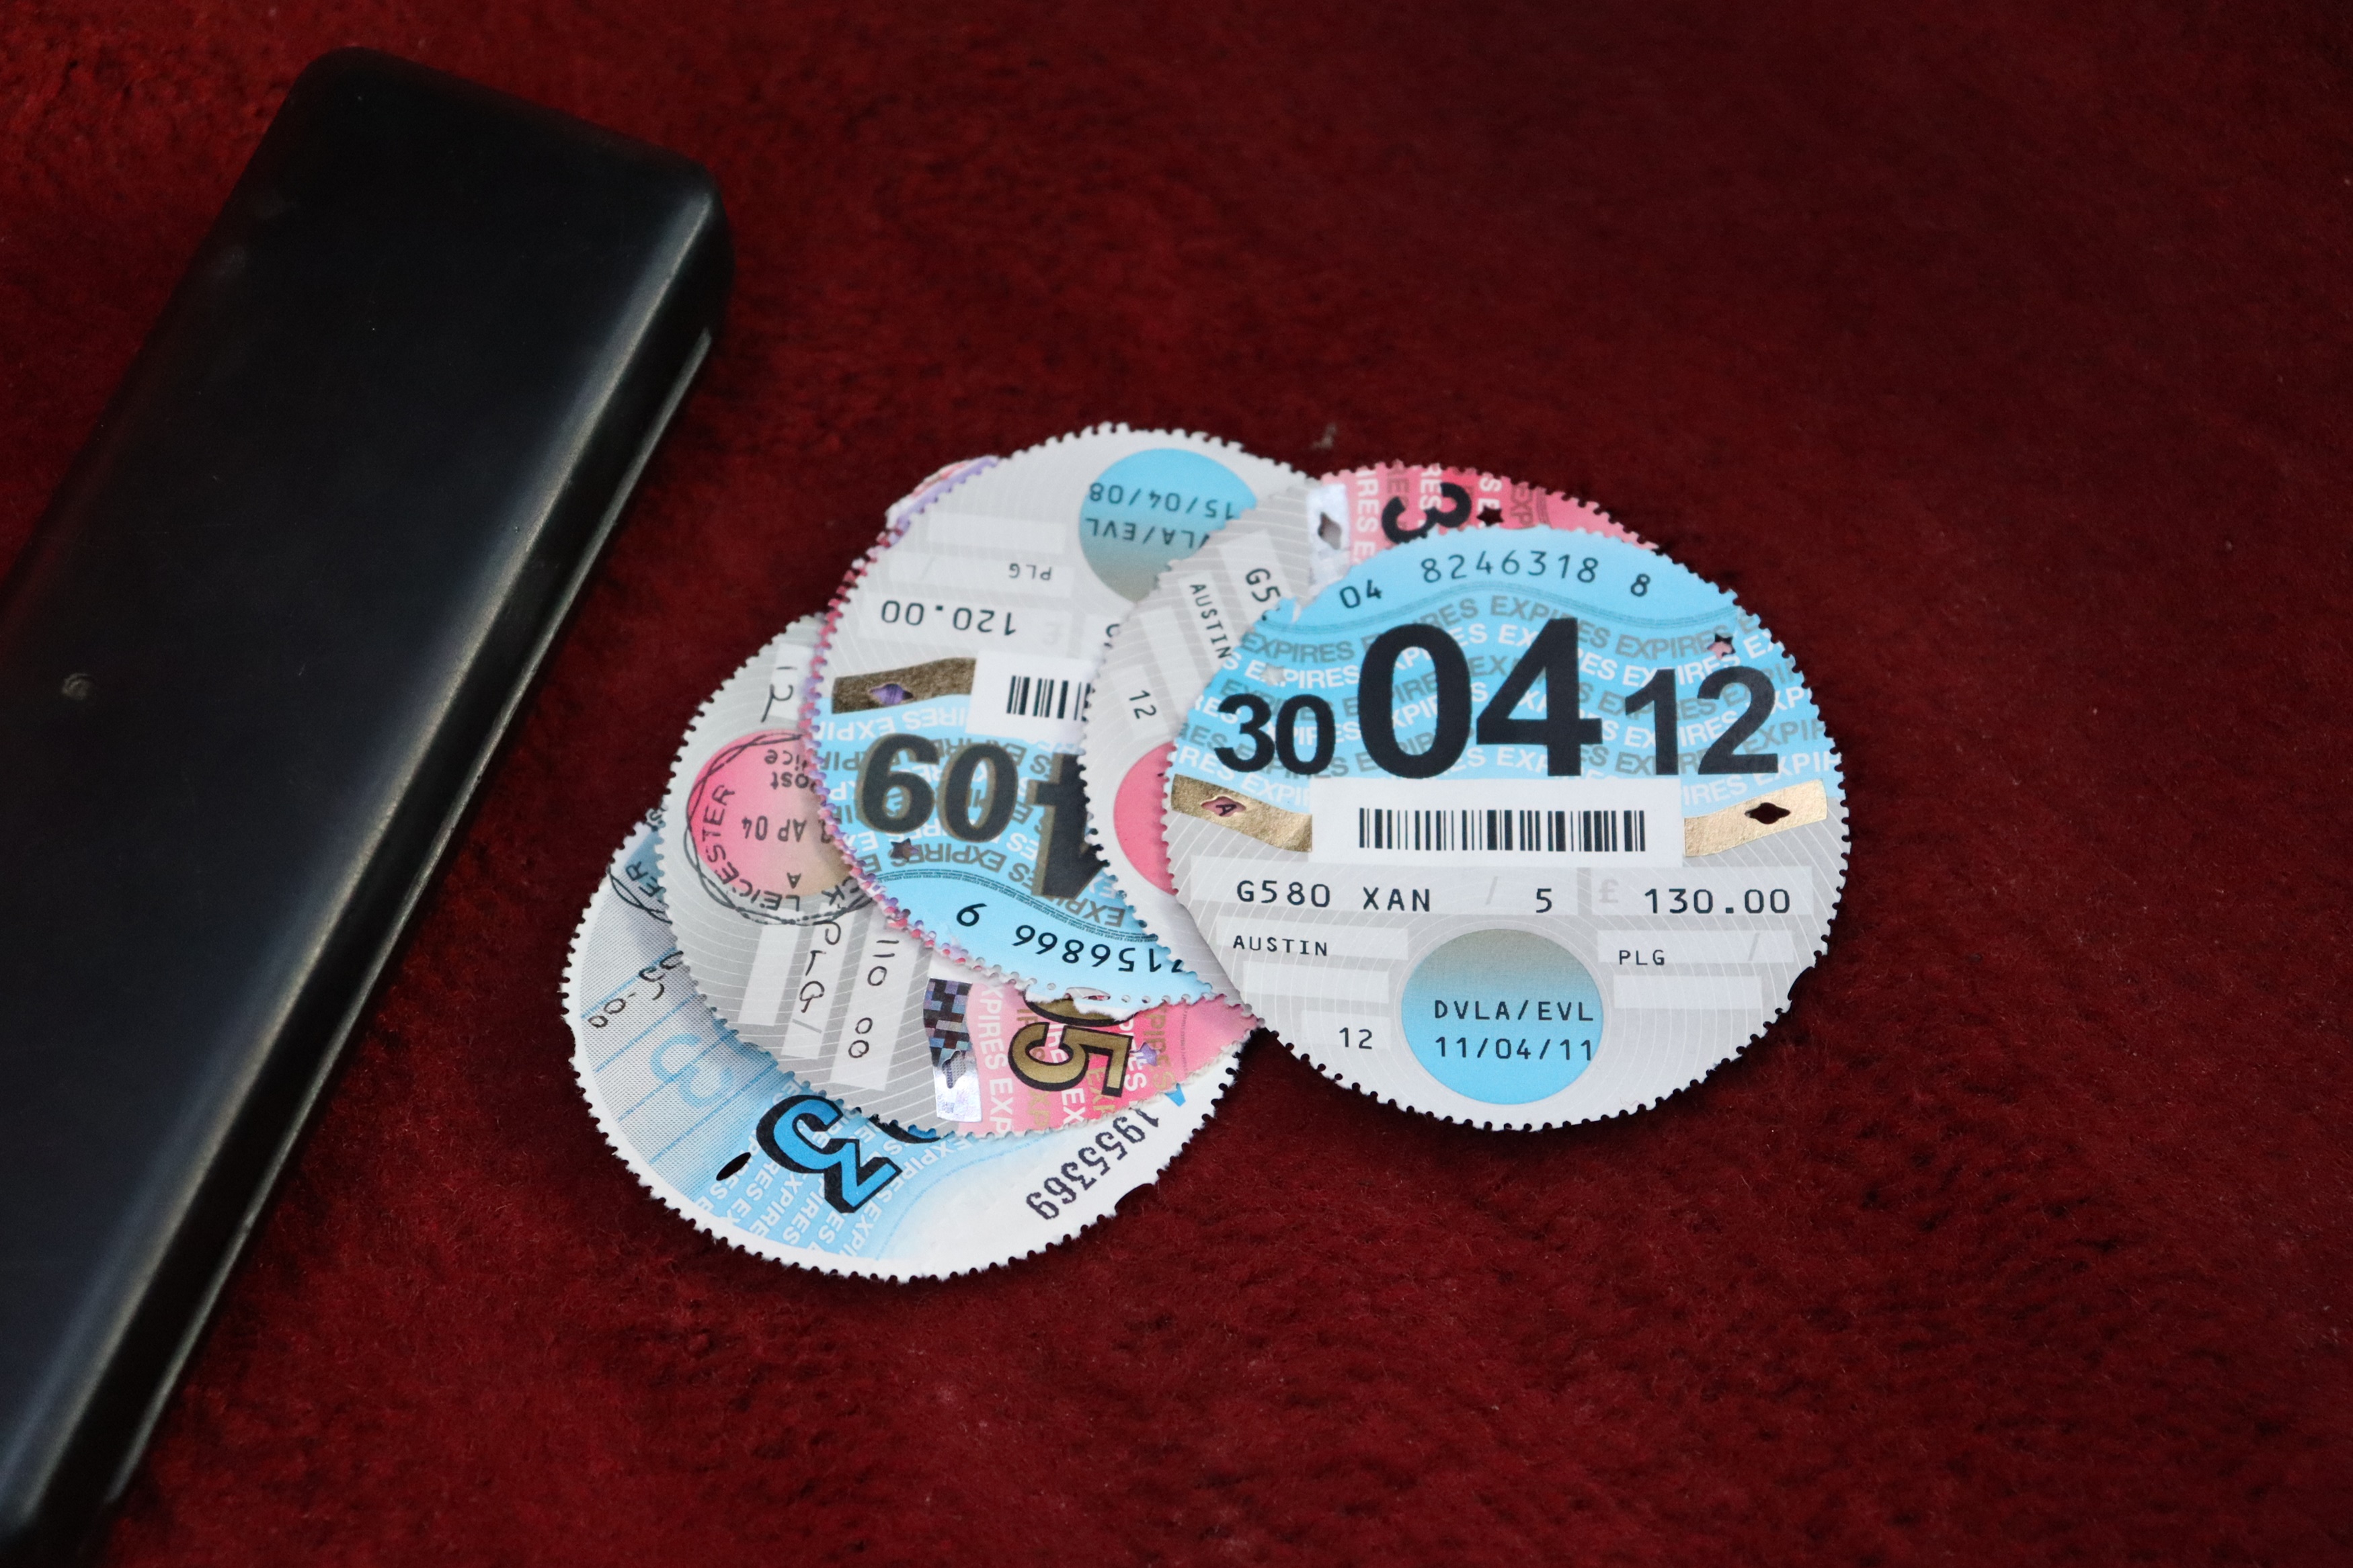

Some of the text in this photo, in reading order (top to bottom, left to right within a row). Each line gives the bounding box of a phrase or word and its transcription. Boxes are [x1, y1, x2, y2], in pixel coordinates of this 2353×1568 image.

[1090, 482, 1235, 520] 15/04/08
[1085, 518, 1209, 550] LA/EVL
[1009, 563, 1052, 581] PLG
[1340, 549, 1651, 608] 04 8246318 8
[881, 600, 1016, 636] 120.00
[1190, 583, 1232, 659] AUSTIN
[1129, 690, 1158, 719] 12
[1214, 693, 1336, 775] 30
[1358, 617, 1603, 779] 04
[1625, 665, 1779, 775] 12
[770, 772, 817, 790] ost
[742, 817, 768, 841] 04
[778, 821, 807, 843] AP
[701, 784, 800, 911] LEICESTER
[1236, 880, 1553, 913] G580 XAN 5
[1644, 888, 1791, 914] 130.00
[1233, 935, 1328, 956] AUSTIN
[1619, 949, 1665, 966] PLG
[1435, 999, 1594, 1022] DVLA/EVL
[1339, 1027, 1373, 1050] 12
[1435, 1037, 1593, 1061] 11/04/11
[1026, 1109, 1159, 1221] 1955369
